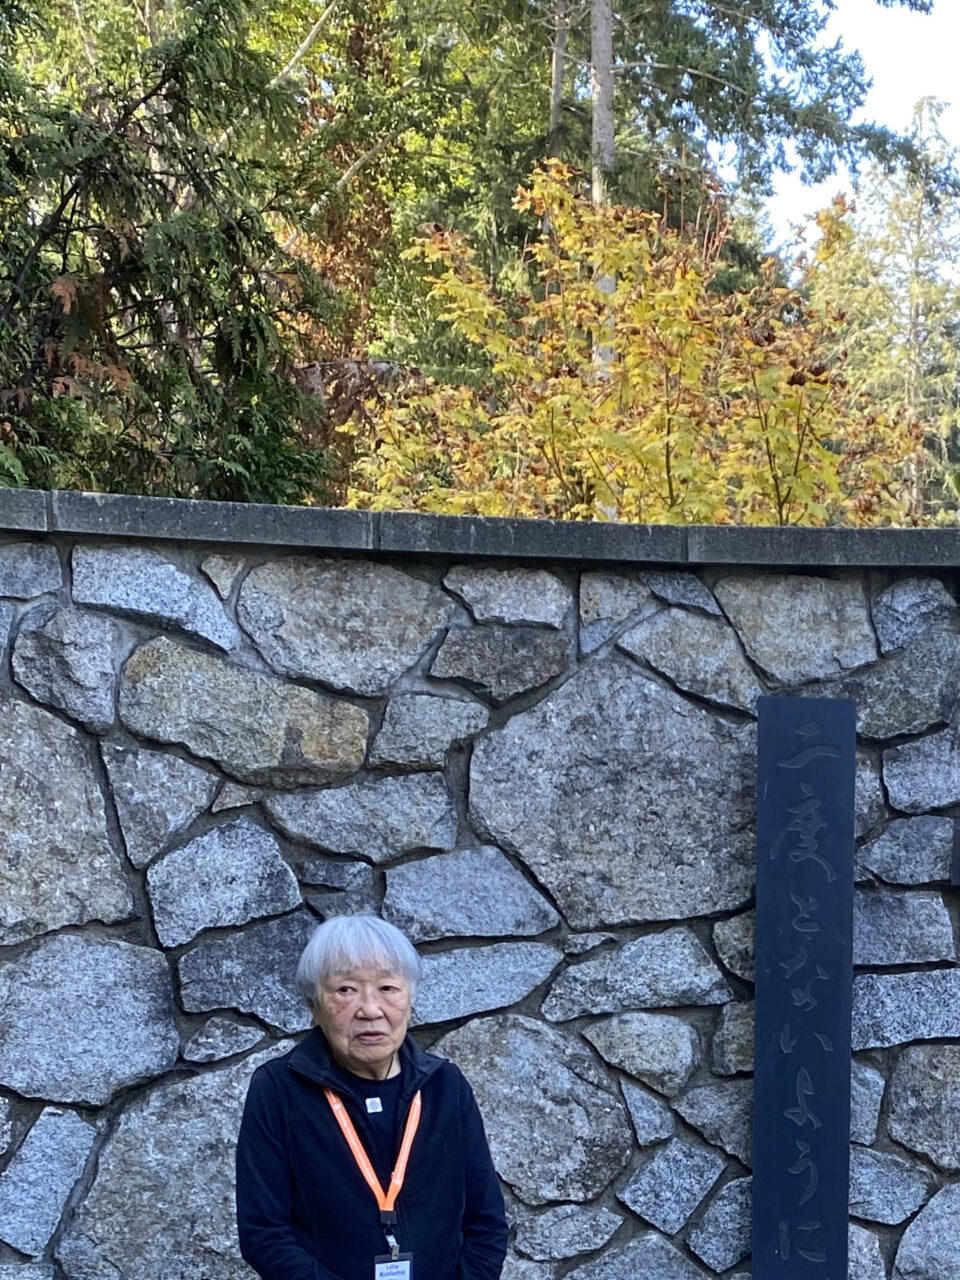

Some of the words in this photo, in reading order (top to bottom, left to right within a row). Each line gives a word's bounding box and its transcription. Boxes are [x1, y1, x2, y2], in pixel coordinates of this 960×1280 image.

[771, 719, 842, 1264] 二度とないように
